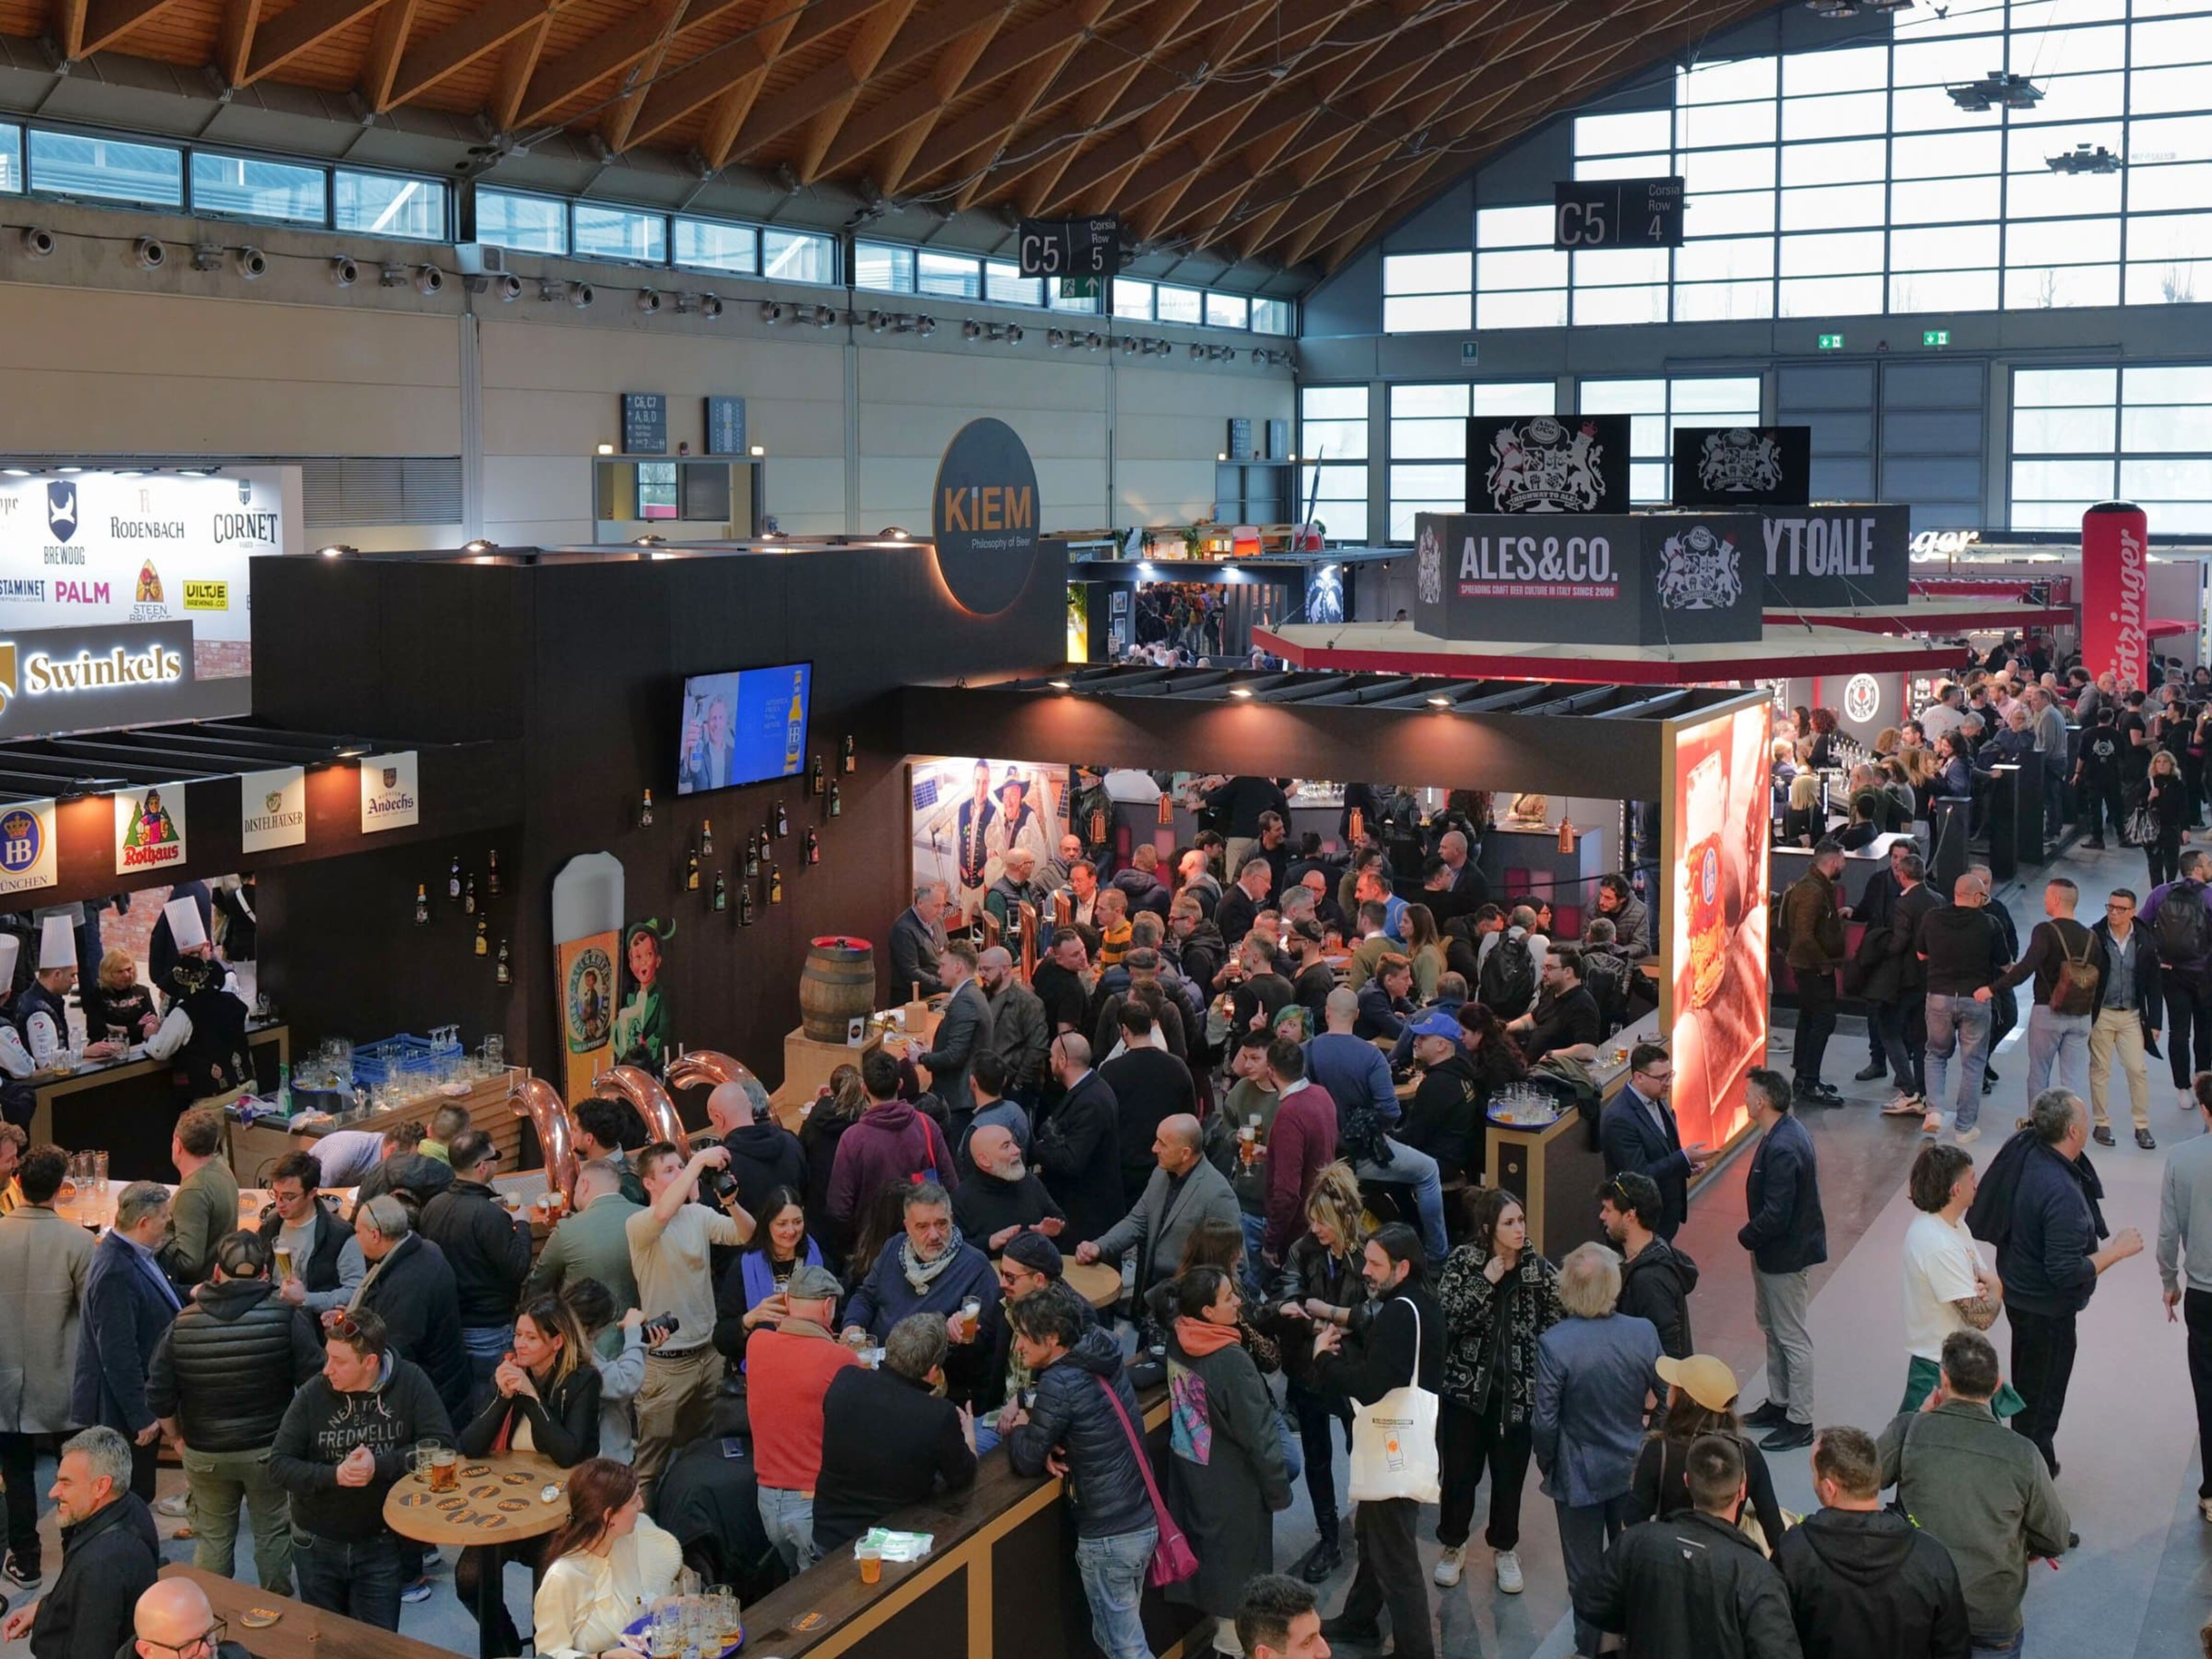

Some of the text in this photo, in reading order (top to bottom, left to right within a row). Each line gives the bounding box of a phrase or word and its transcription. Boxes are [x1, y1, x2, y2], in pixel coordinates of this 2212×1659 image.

[1649, 184, 1680, 196] Corsia
[1649, 200, 1671, 211] Row
[1090, 220, 1116, 231] Corsia
[1558, 202, 1605, 245] C5
[1648, 215, 1663, 242] 4
[1092, 233, 1109, 244] Row
[1022, 235, 1059, 273] C5
[1092, 247, 1103, 270] 5
[647, 397, 656, 408] C7
[1537, 420, 1555, 429] Ales
[1513, 491, 1547, 502] HIGHWAY
[1560, 492, 1575, 502] ALE
[945, 486, 1031, 532] KIEM
[111, 516, 184, 539] RODENBACH
[214, 513, 277, 544] CORNET
[972, 535, 1030, 550] Philosophy of Beer
[1909, 530, 1979, 563] ger
[44, 546, 85, 565] BREWDOG
[1460, 537, 1618, 581] ALES&CO.
[0, 579, 45, 602] STAMINET
[55, 581, 110, 603] PALM
[186, 585, 225, 598] UILTJE
[1510, 586, 1523, 595] BEER
[1524, 586, 1548, 596] CULTURE
[1556, 586, 1571, 596] ITALY
[1572, 587, 1593, 596] SINCE
[1595, 587, 1614, 597] 2006
[134, 604, 167, 615] STEEN
[31, 646, 181, 690] Swinkels
[367, 793, 414, 814] Andechs
[6, 838, 32, 865] HB
[123, 845, 179, 866] Rothaus
[0, 875, 47, 891] ÜNCHEN
[319, 1421, 404, 1449] FREDMELLO
